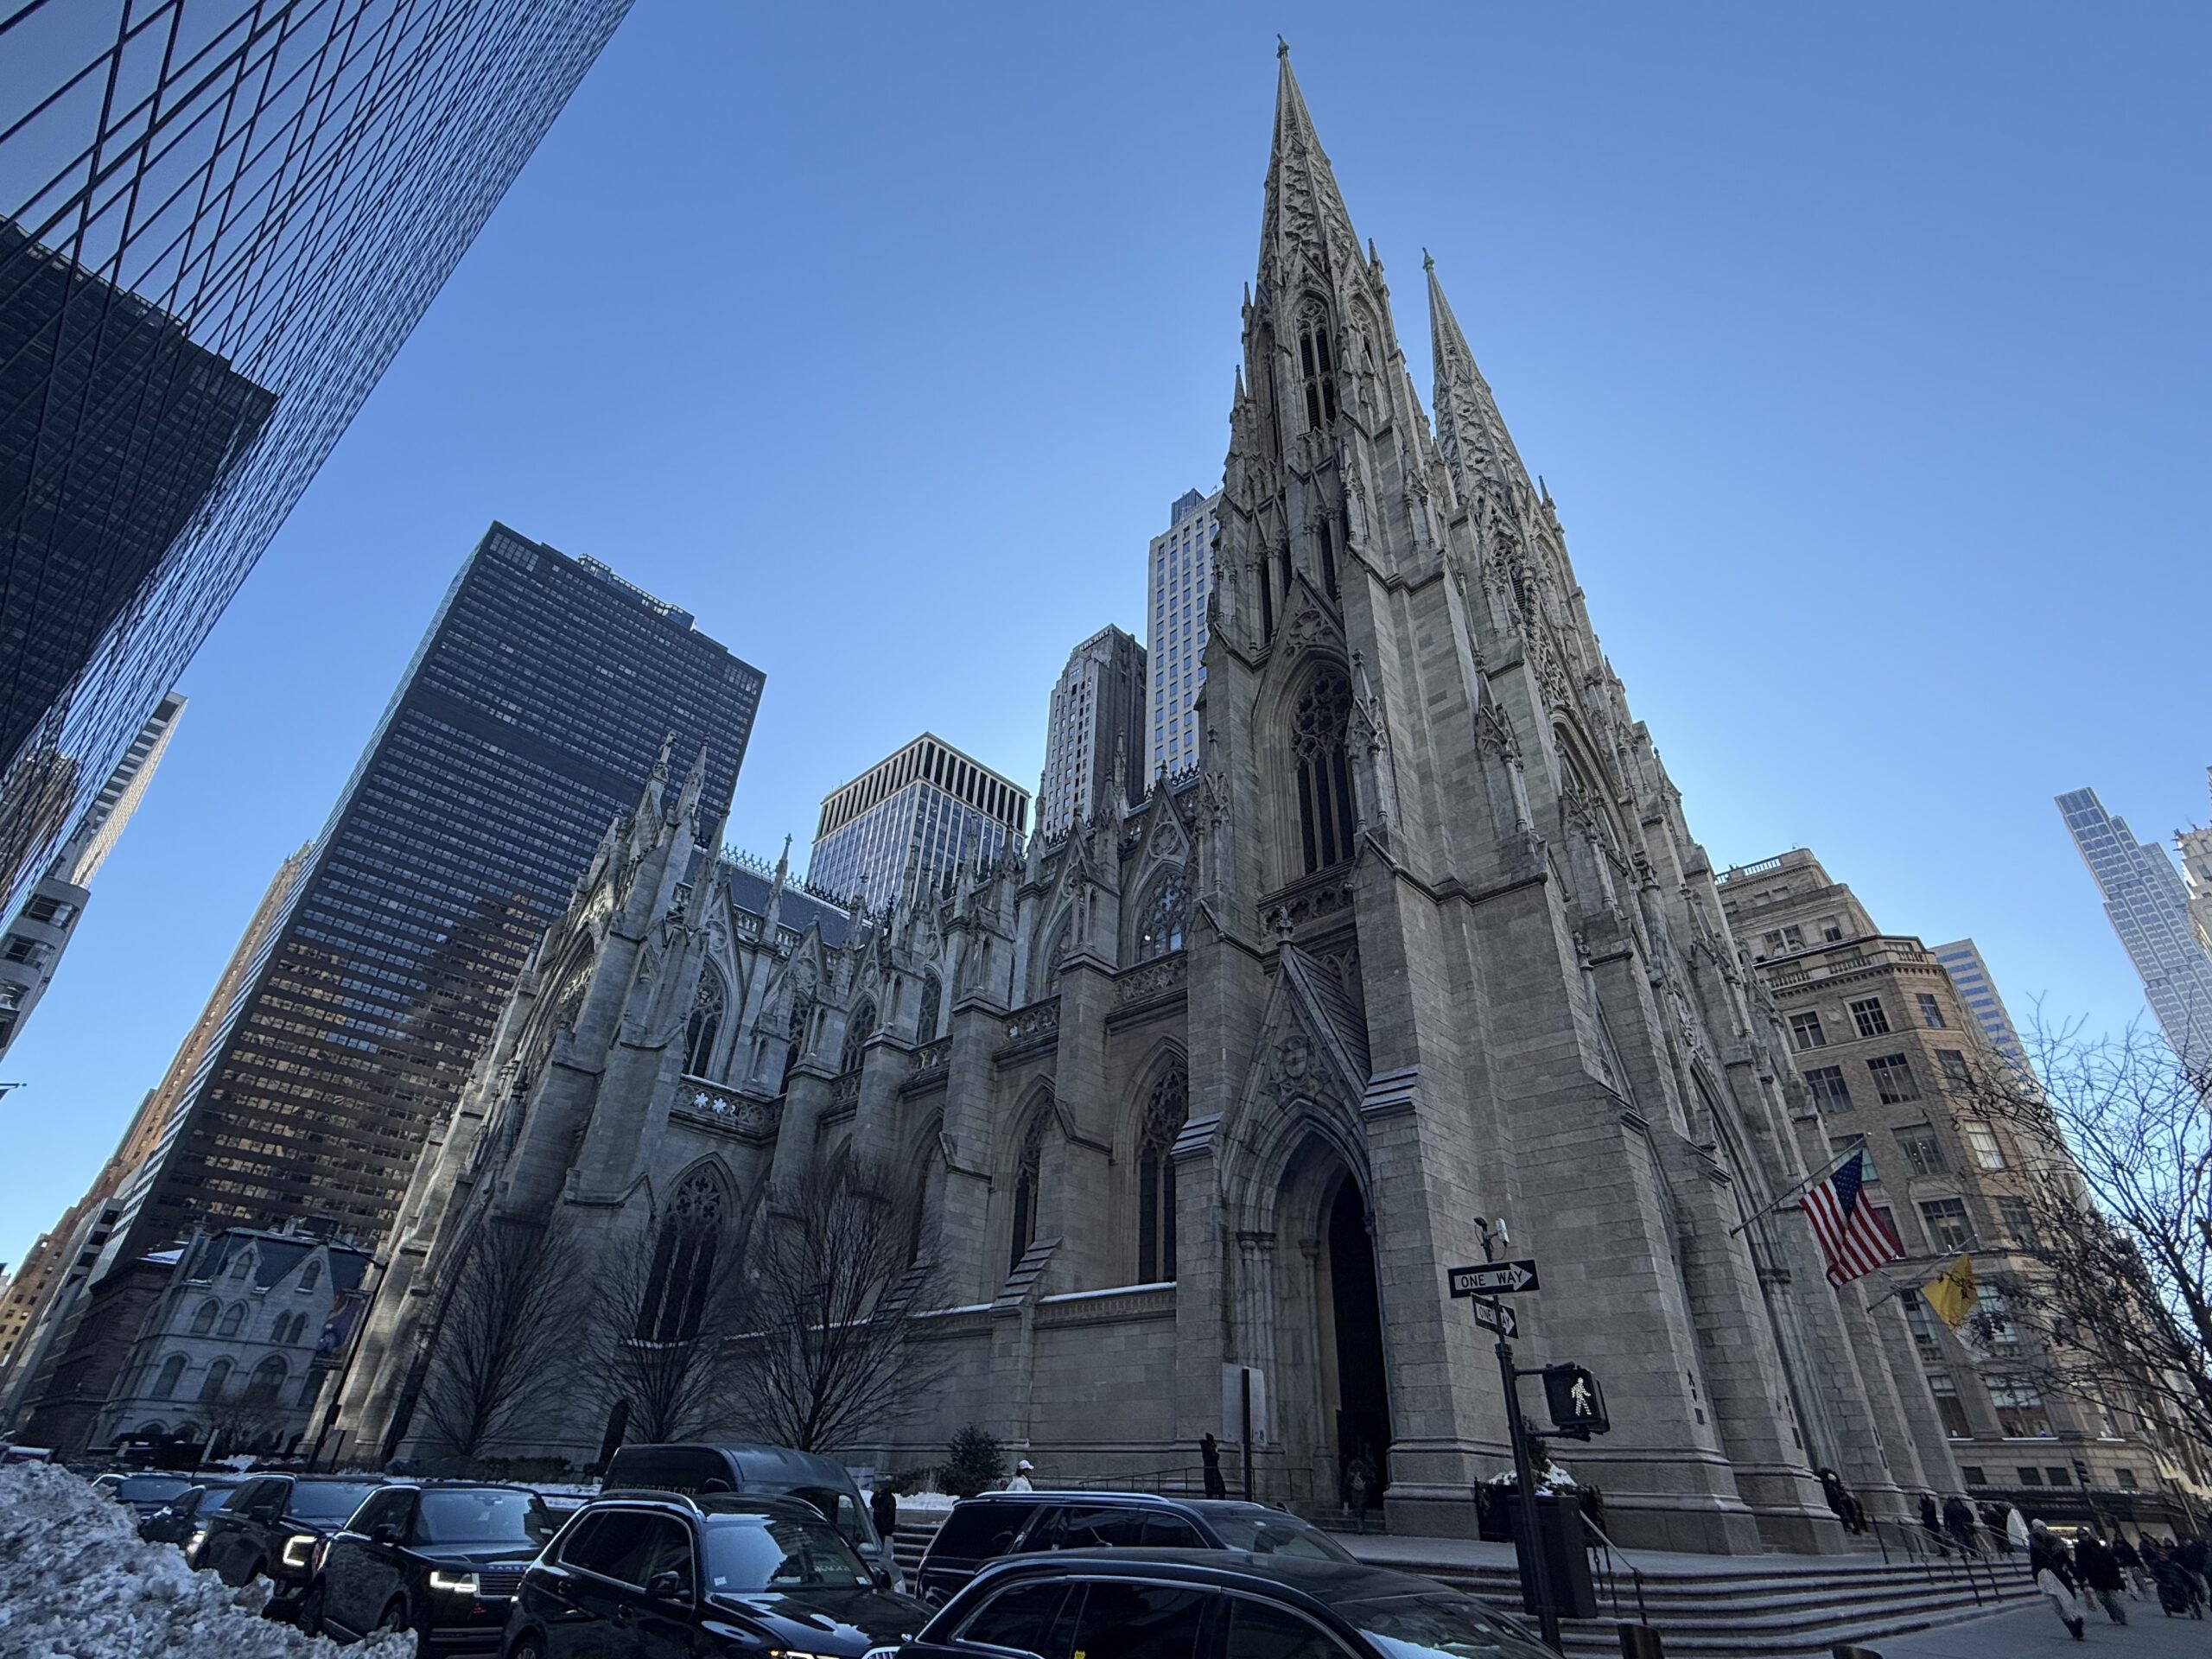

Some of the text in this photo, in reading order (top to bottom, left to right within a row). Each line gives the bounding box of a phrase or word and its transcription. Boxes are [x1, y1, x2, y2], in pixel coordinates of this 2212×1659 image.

[1461, 1270, 1522, 1288] ONE WAY
[1478, 1306, 1492, 1322] ONE
